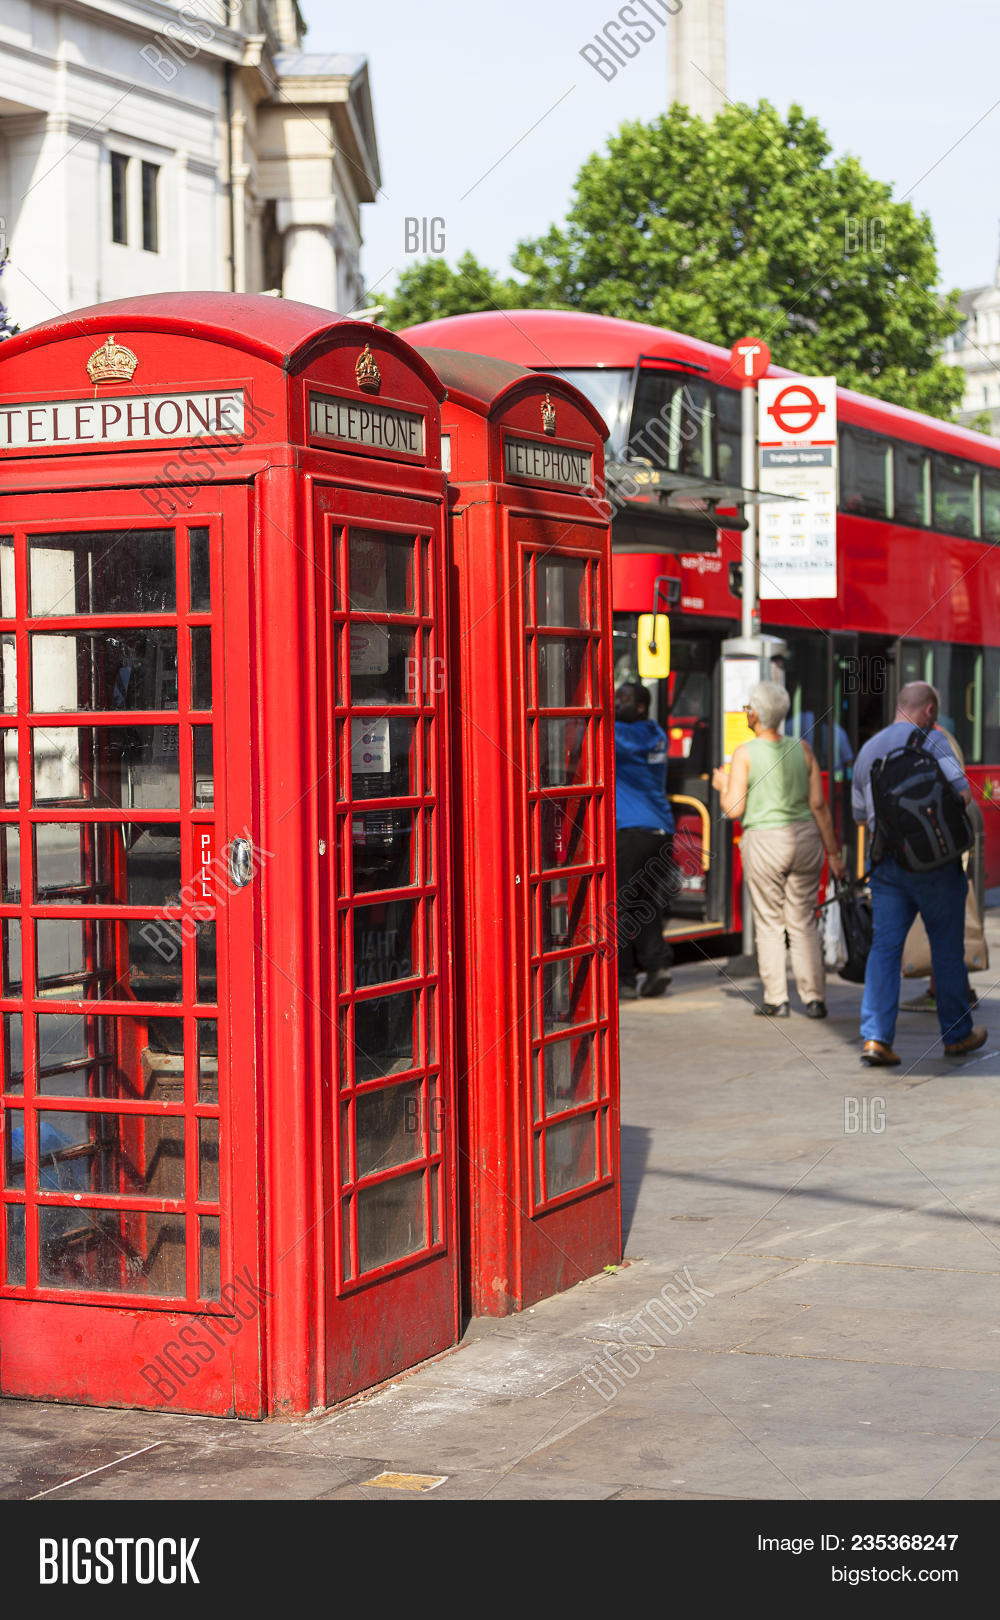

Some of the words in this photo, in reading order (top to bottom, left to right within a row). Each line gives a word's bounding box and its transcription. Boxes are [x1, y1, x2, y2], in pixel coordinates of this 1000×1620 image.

[738, 346, 760, 376] T
[1, 396, 236, 444] TELEPHONE
[311, 400, 418, 452] TELEPHONE
[505, 443, 588, 484] TELEPHONE
[201, 834, 212, 897] PULL
